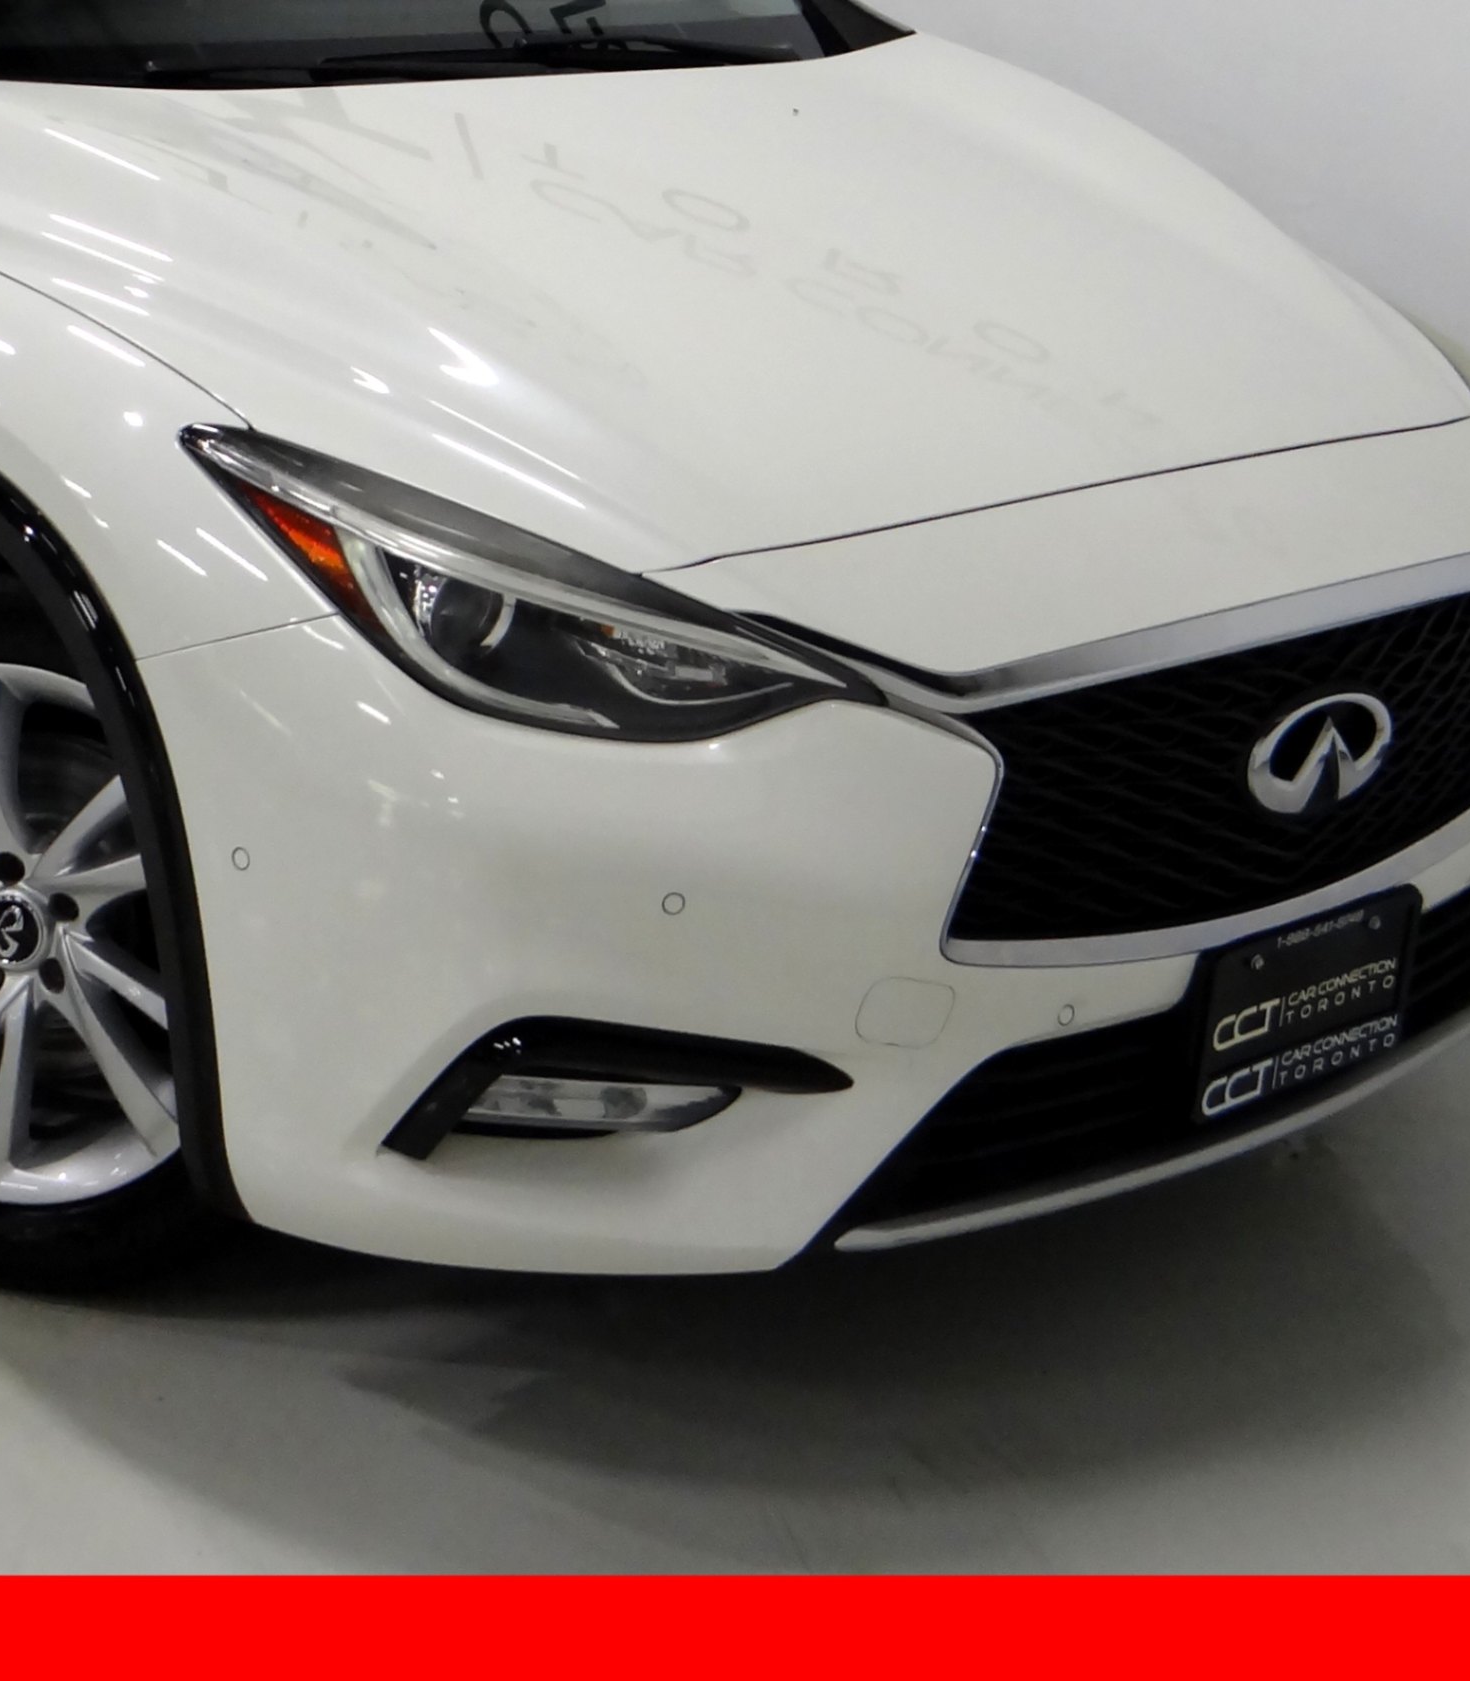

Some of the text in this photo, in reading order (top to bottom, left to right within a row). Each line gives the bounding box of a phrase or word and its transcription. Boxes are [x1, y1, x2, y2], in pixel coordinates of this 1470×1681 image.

[1285, 974, 1395, 1024] TORONTO
[1287, 957, 1397, 1006] CAR CONNECTION
[1212, 997, 1281, 1052] CCT
[1281, 1014, 1398, 1066] CAR CONNECTION
[1279, 1033, 1396, 1086] TORONTO
[1201, 1057, 1274, 1116] CCT
